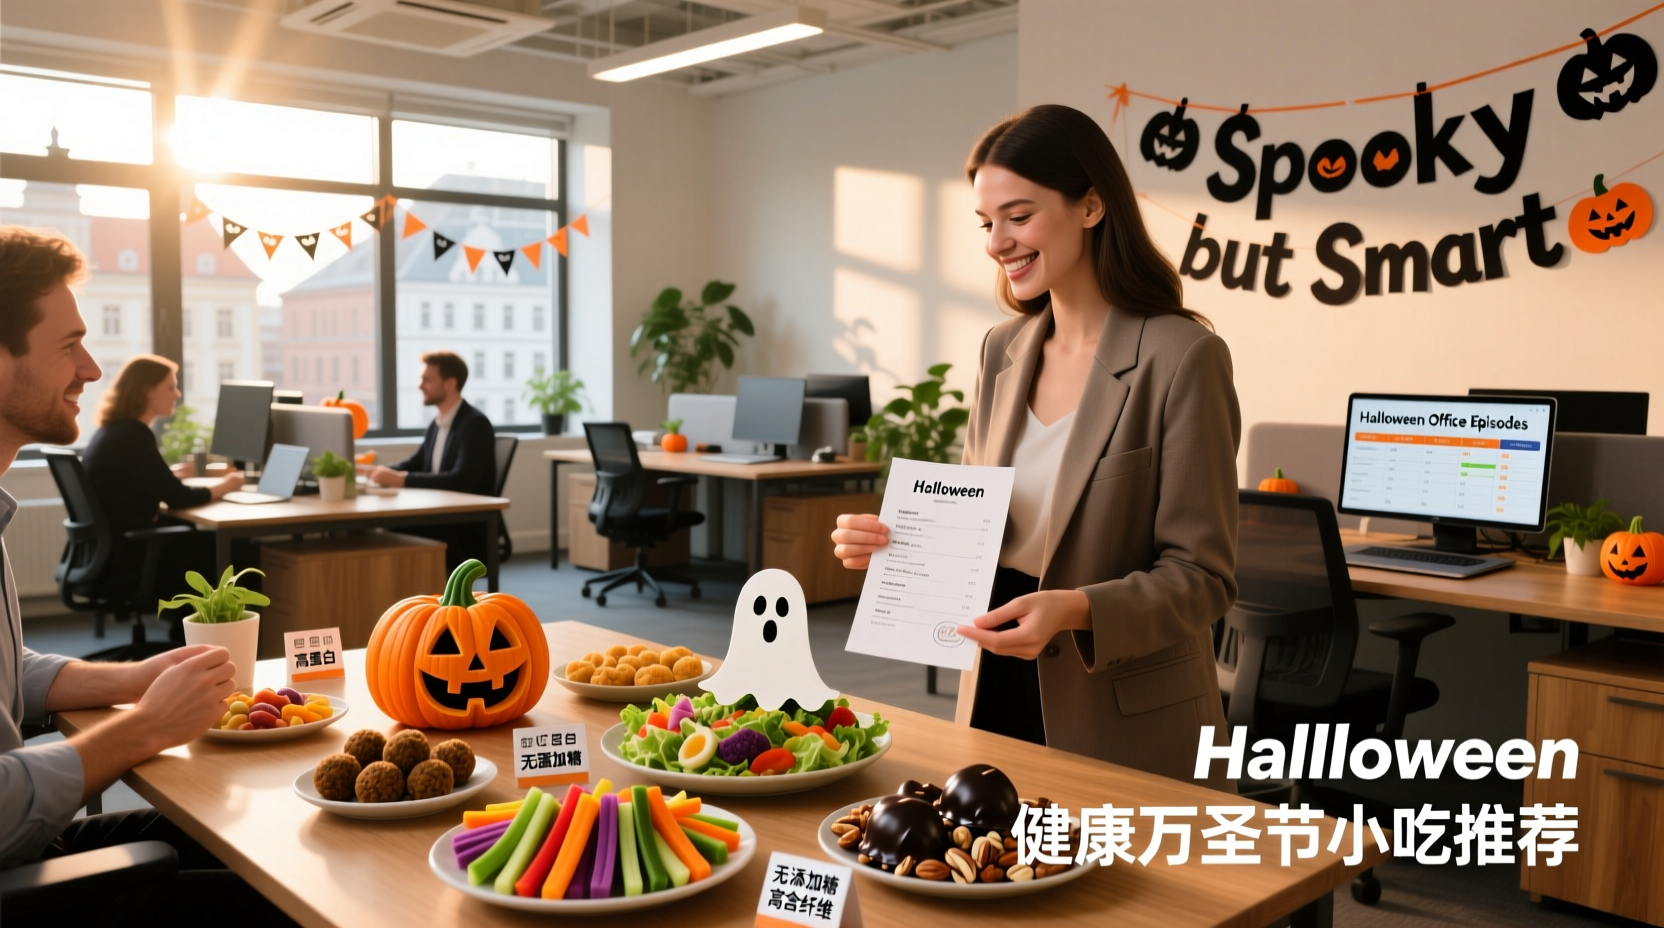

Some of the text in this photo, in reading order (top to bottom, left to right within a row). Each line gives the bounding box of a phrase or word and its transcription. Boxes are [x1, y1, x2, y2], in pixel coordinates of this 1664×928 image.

[1206, 83, 1534, 220] Spooky
[1179, 192, 1564, 306] but Smart
[1360, 411, 1425, 426] Halloween
[1428, 413, 1467, 428] Office
[913, 480, 985, 498] Halloween
